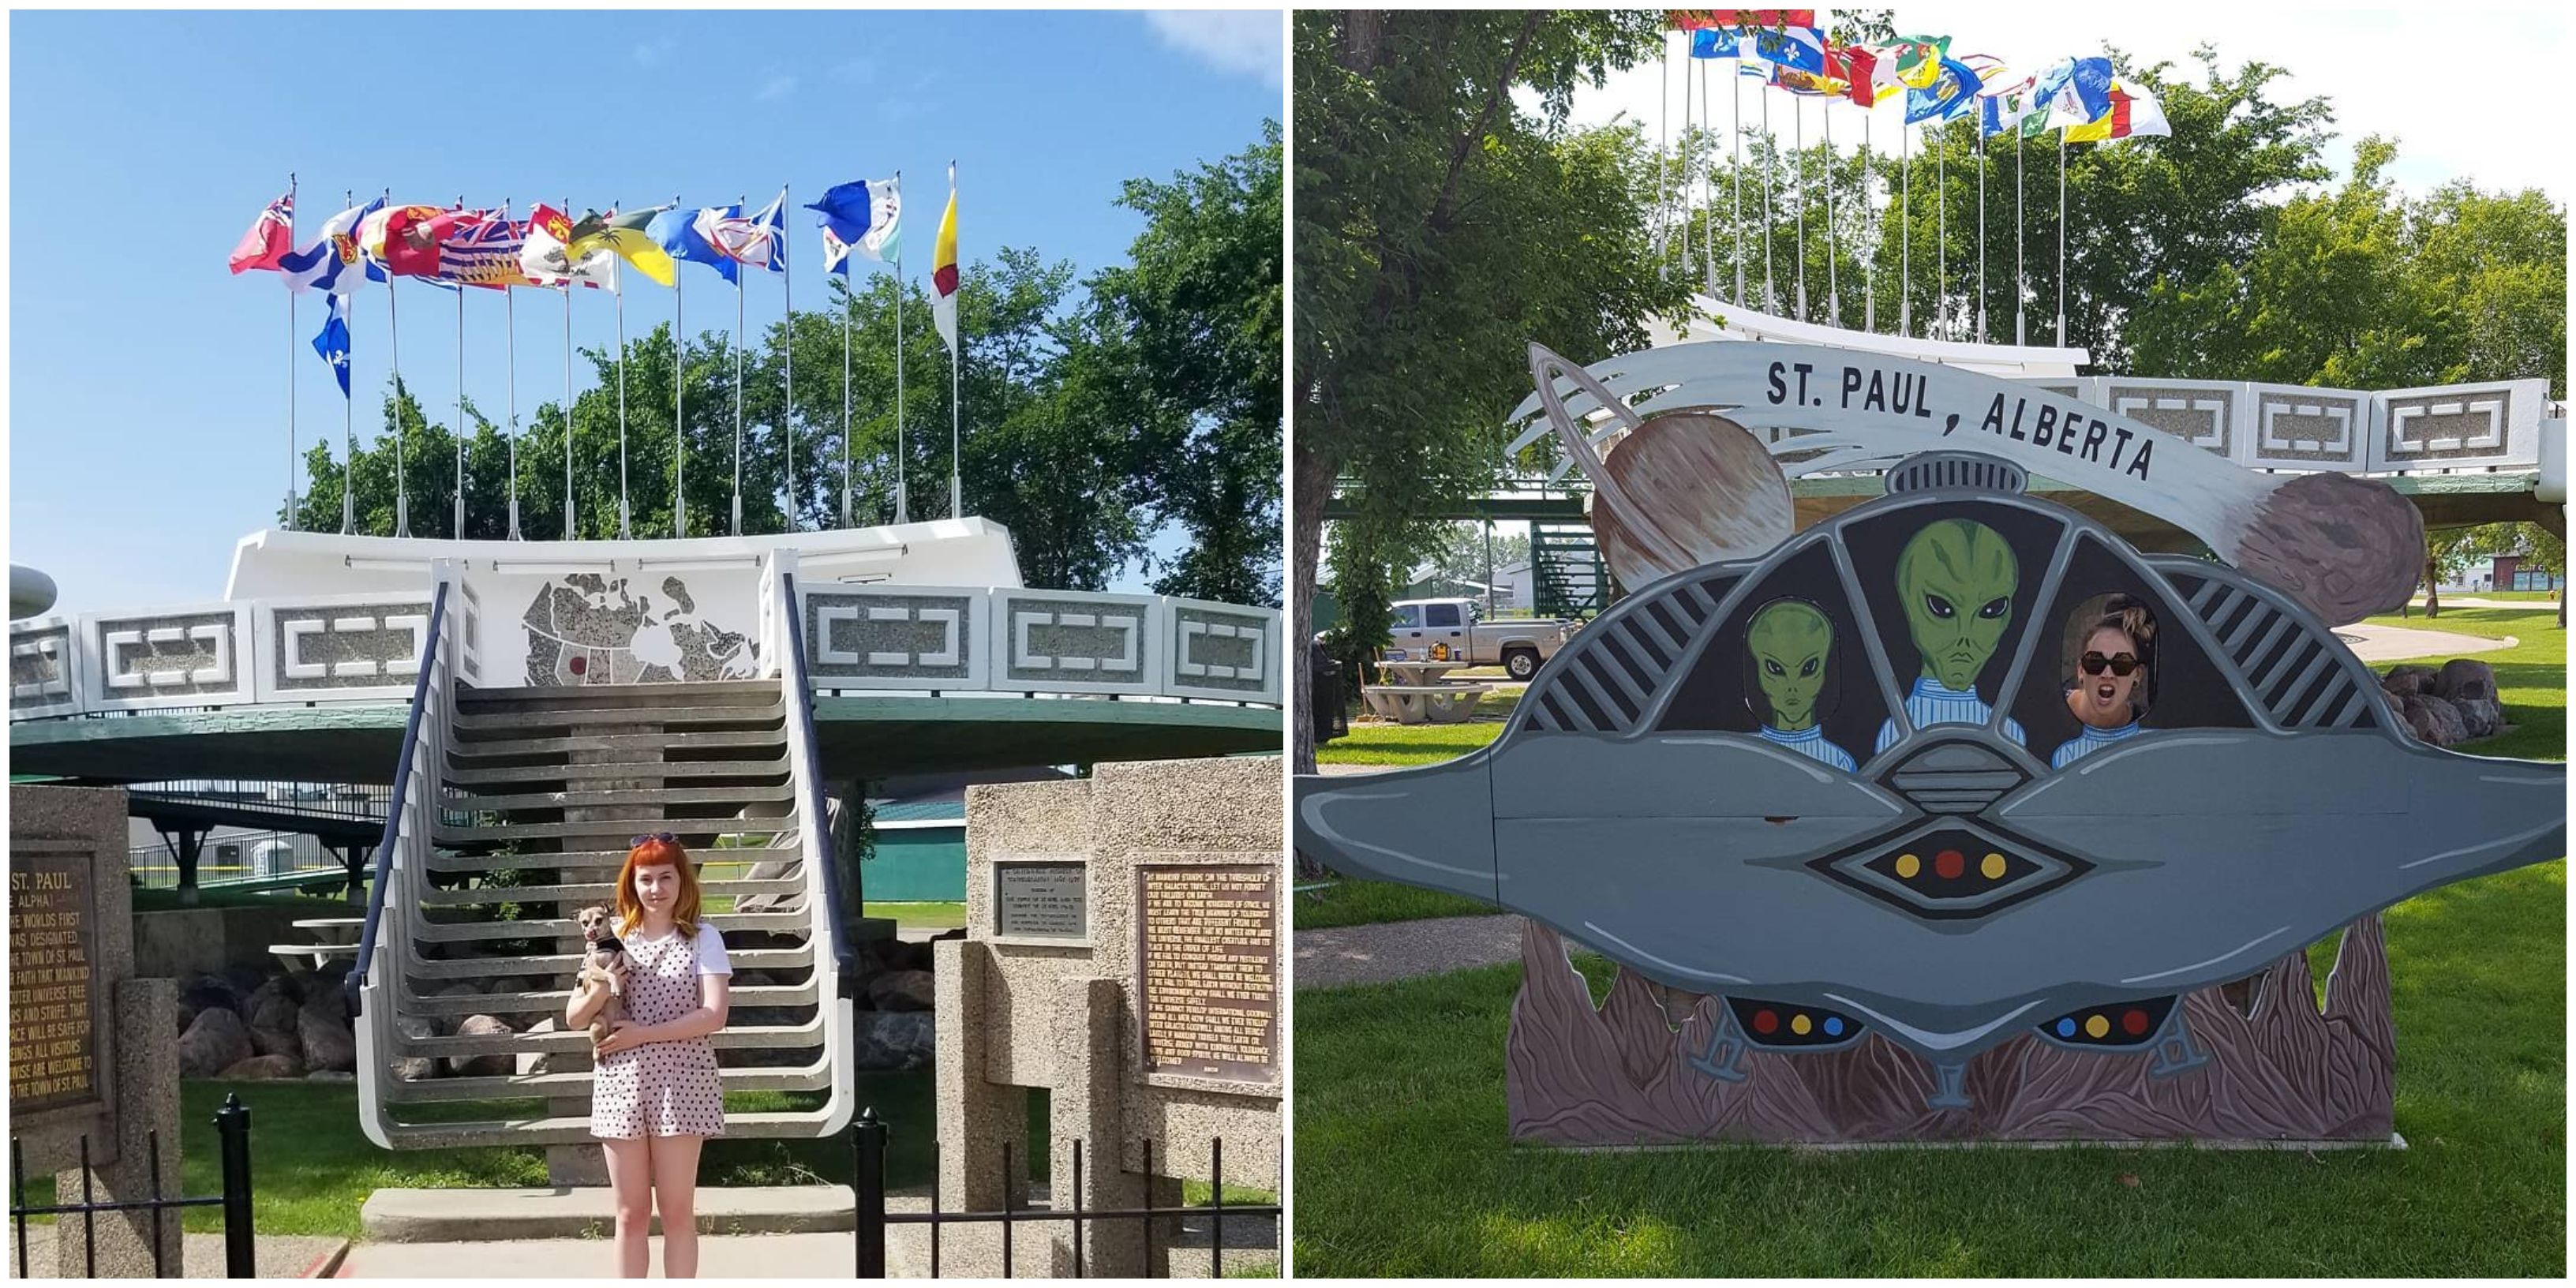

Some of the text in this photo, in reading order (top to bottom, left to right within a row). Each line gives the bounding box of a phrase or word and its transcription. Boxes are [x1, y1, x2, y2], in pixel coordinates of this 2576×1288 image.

[1766, 361, 1822, 407] ST.
[1981, 392, 2155, 482] ALBERTA
[12, 872, 72, 890] ST. PAUL
[58, 912, 80, 927] FIRST
[30, 930, 77, 945] DESIGNATED
[21, 950, 44, 965] TOWN
[46, 949, 55, 964] OF
[68, 948, 85, 962] PAUL
[17, 969, 36, 985] FAITH
[37, 968, 54, 983] THAT
[55, 966, 89, 982] MANKIND
[32, 986, 66, 1002] UNIVERSE
[69, 984, 85, 1000] FREE
[23, 1007, 39, 1022] AND
[69, 1002, 88, 1019] THAT
[28, 1025, 47, 1041] WILL
[47, 1024, 56, 1039] BE
[57, 1022, 76, 1037] SAFE
[77, 1020, 91, 1035] FOR
[35, 1043, 48, 1058] ALL
[51, 1039, 80, 1057] VISITORS
[32, 1061, 46, 1076] ARE
[47, 1058, 82, 1075] WELCOME
[84, 1055, 92, 1070] TO
[17, 1083, 30, 1099] THE
[31, 1080, 52, 1097] TOWN
[53, 1078, 61, 1093] OF
